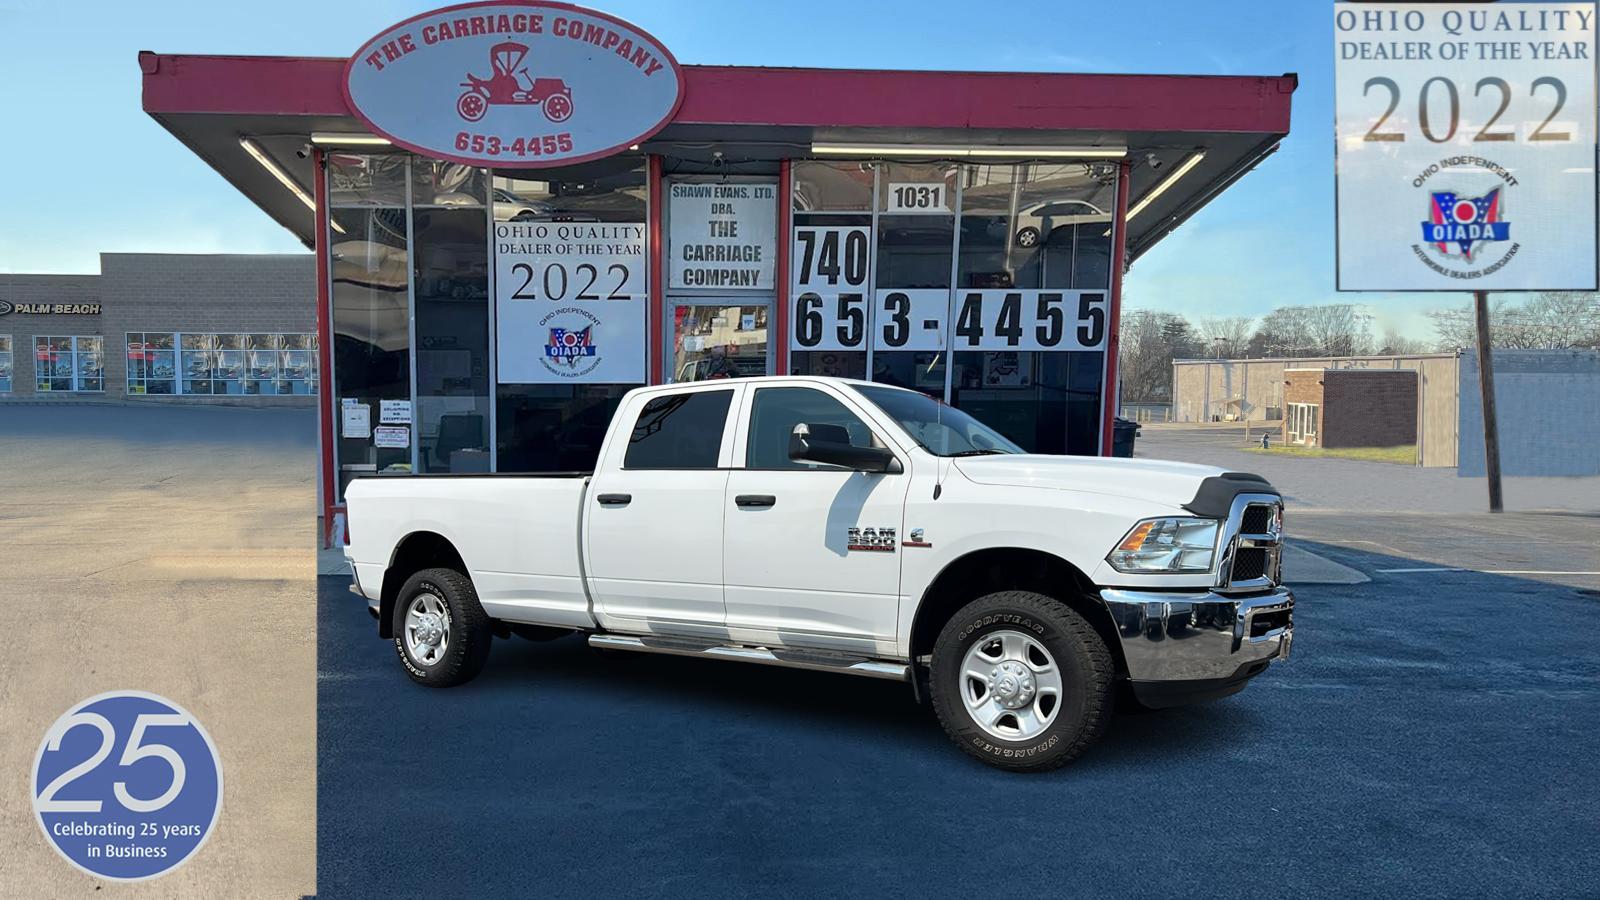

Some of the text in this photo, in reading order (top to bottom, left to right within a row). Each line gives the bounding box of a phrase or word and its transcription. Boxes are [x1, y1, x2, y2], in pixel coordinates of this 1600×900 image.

[1336, 10, 1592, 36] OHIO QUALITY
[366, 14, 663, 77] THE CARRIAGE COMPANY
[1340, 42, 1589, 60] DEALER OF THE YEAR
[1363, 76, 1570, 143] 2022
[455, 132, 573, 156] 653-4455
[1412, 156, 1519, 188] OHIO INDEPENDENT
[673, 186, 712, 198] SHAWN
[754, 187, 774, 199] LTD.
[894, 186, 940, 208] 1031
[711, 203, 736, 215] DBA.
[497, 226, 644, 241] OHIO QUALITY
[709, 221, 738, 237] THE
[1432, 224, 1495, 240] OIADA
[499, 244, 641, 255] DEALER OF THE YEAR
[683, 244, 762, 262] CARRIAGE
[797, 230, 868, 286] 740
[1411, 243, 1449, 277] AUTOMOBILE
[1450, 270, 1482, 279] DEALERS
[511, 263, 632, 301] 2022
[683, 268, 761, 286] COMPANY
[14, 304, 100, 314] PALM BEACH
[539, 307, 601, 327] OHIO INDEPENDENT
[550, 346, 588, 356] OIADA
[848, 527, 896, 537] RAM
[958, 613, 1045, 641] GOODYEAR
[973, 734, 1059, 757] WRANGLER
